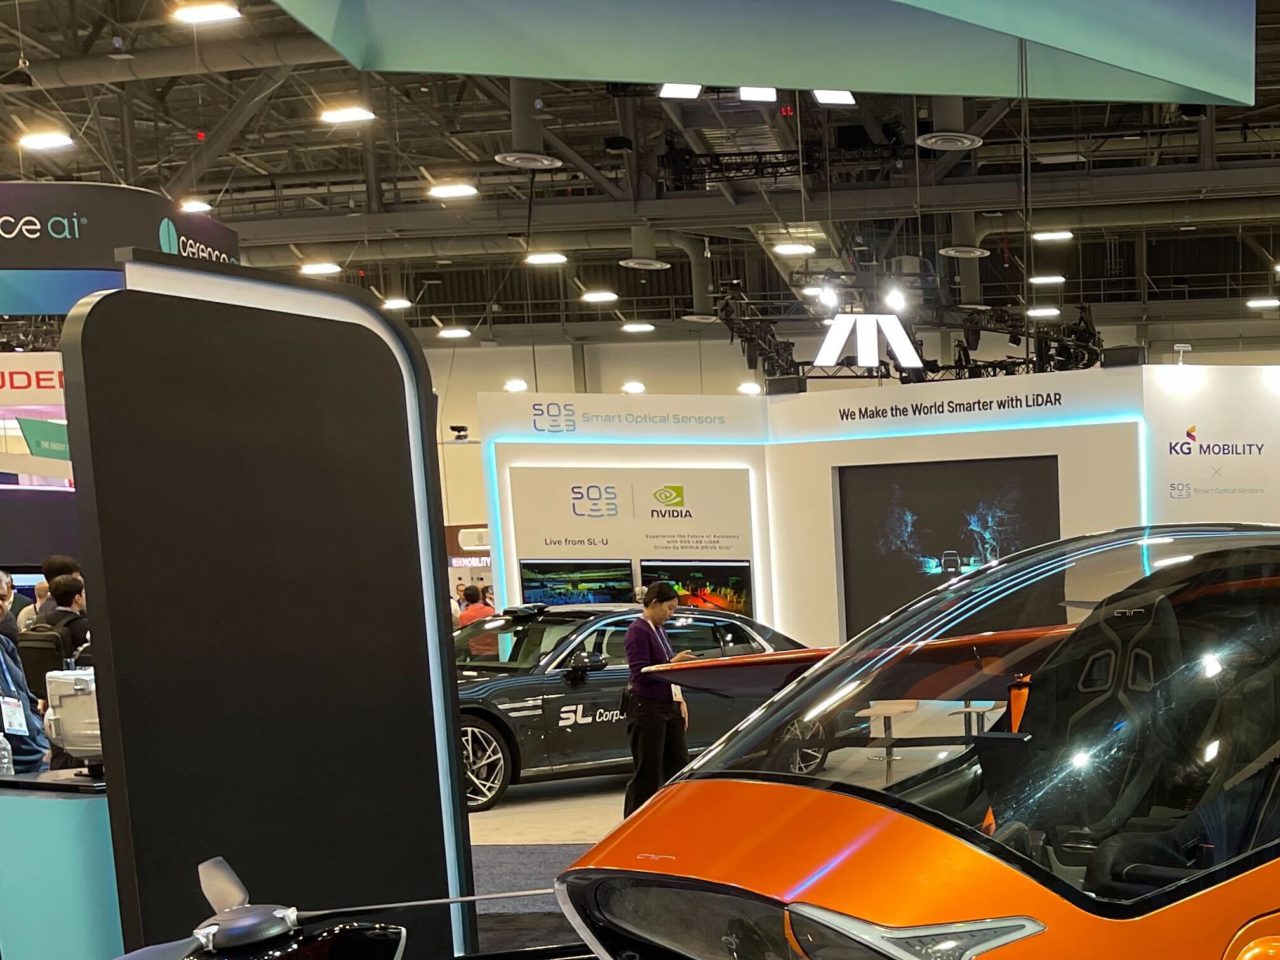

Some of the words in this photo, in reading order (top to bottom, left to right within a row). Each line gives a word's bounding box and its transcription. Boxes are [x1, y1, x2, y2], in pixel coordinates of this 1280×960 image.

[0, 371, 64, 389] DE
[532, 402, 576, 417] SOS
[839, 408, 856, 421] We
[858, 406, 888, 420] Make
[890, 404, 909, 418] the
[911, 401, 945, 417] World
[947, 398, 994, 414] Smarter
[996, 394, 1023, 410] with
[1025, 392, 1062, 408] LiDAR
[582, 412, 622, 424] Smart
[624, 412, 670, 426] Optical
[672, 413, 726, 425] Sensors
[1169, 442, 1192, 455] KG
[1199, 443, 1265, 456] MOBILITY
[571, 485, 617, 501] SOS
[651, 509, 693, 519] NVIDIA
[544, 538, 563, 546] Live
[564, 538, 586, 546] from
[587, 538, 609, 546] SL-U
[559, 704, 593, 727] SL
[595, 708, 628, 723] Corp
